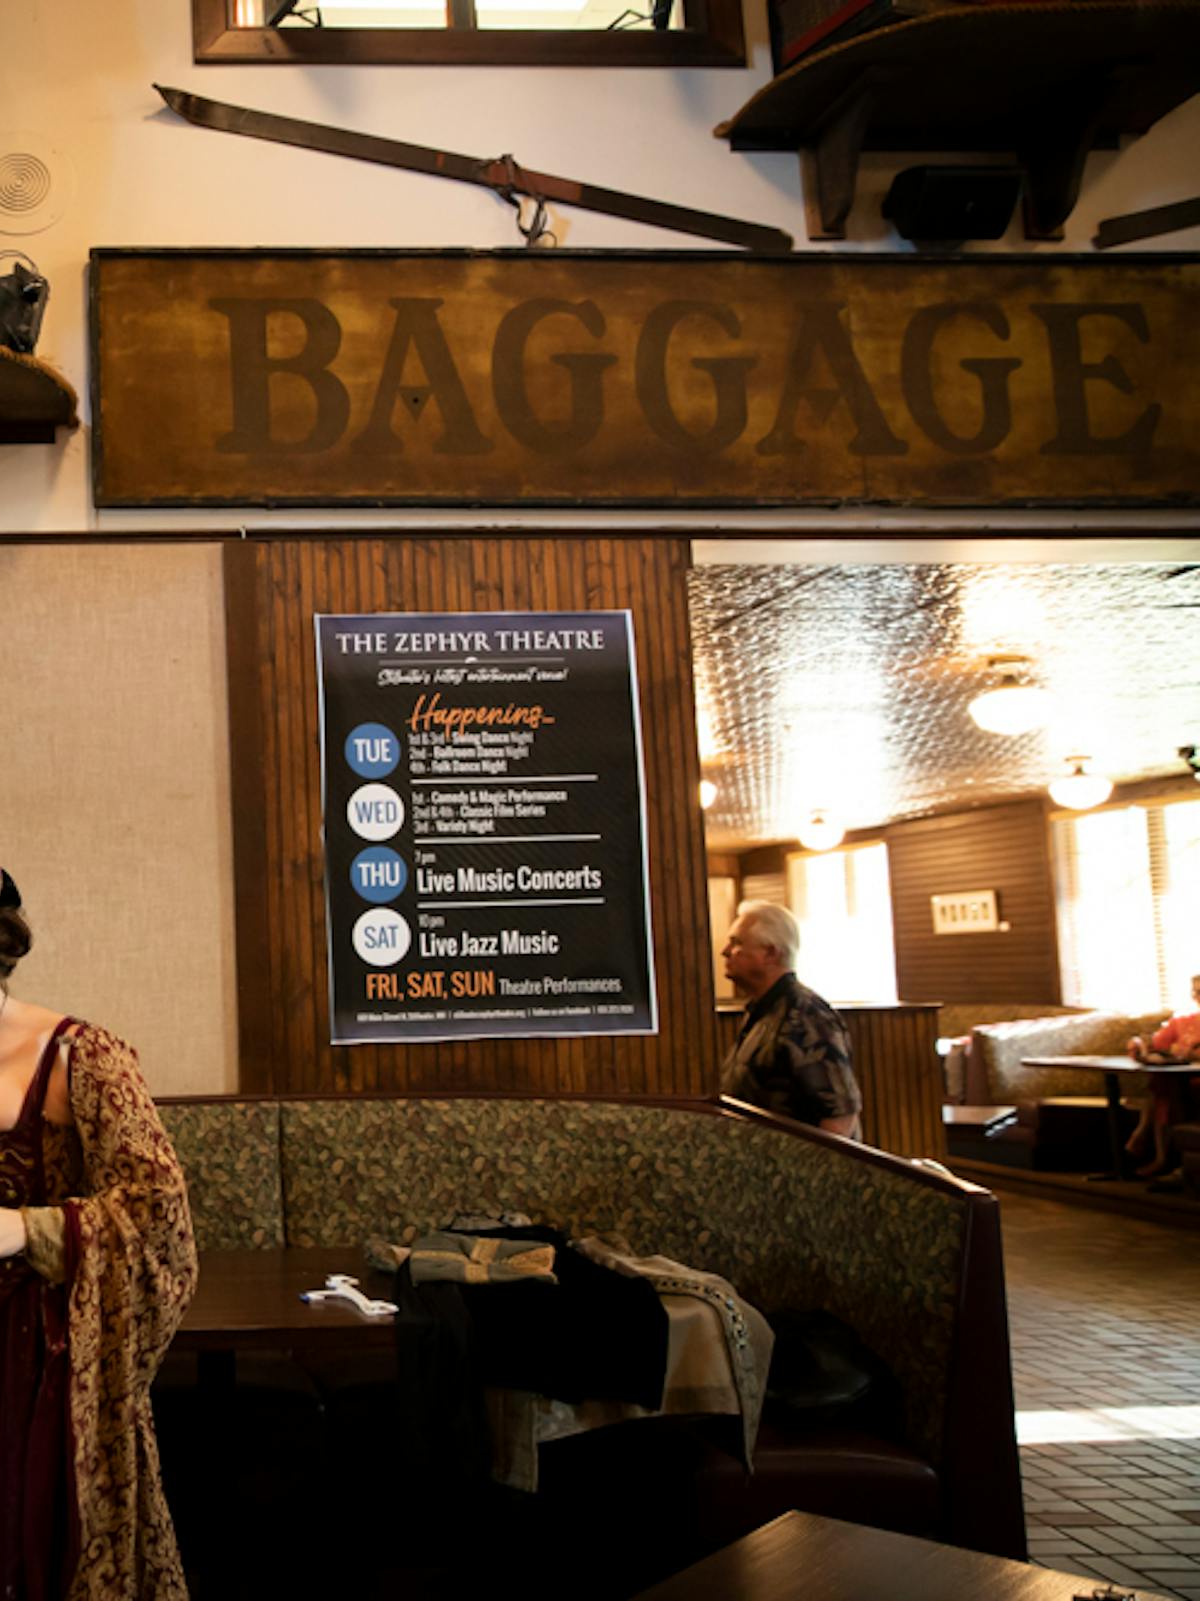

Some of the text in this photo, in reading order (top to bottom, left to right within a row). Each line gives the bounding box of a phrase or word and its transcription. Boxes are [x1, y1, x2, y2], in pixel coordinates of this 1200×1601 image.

[209, 296, 1162, 458] BAGGAGE
[336, 629, 605, 653] THE ZEPHYR THEATRE
[353, 738, 393, 763] TUE
[355, 800, 398, 824] WED
[357, 861, 400, 887] THU
[416, 865, 602, 894] Live Music Concerts
[364, 925, 399, 949] SAT
[419, 929, 560, 958] Live Jazz Music
[366, 970, 622, 1001] FRI, SAT, SUN Theatre Performances
